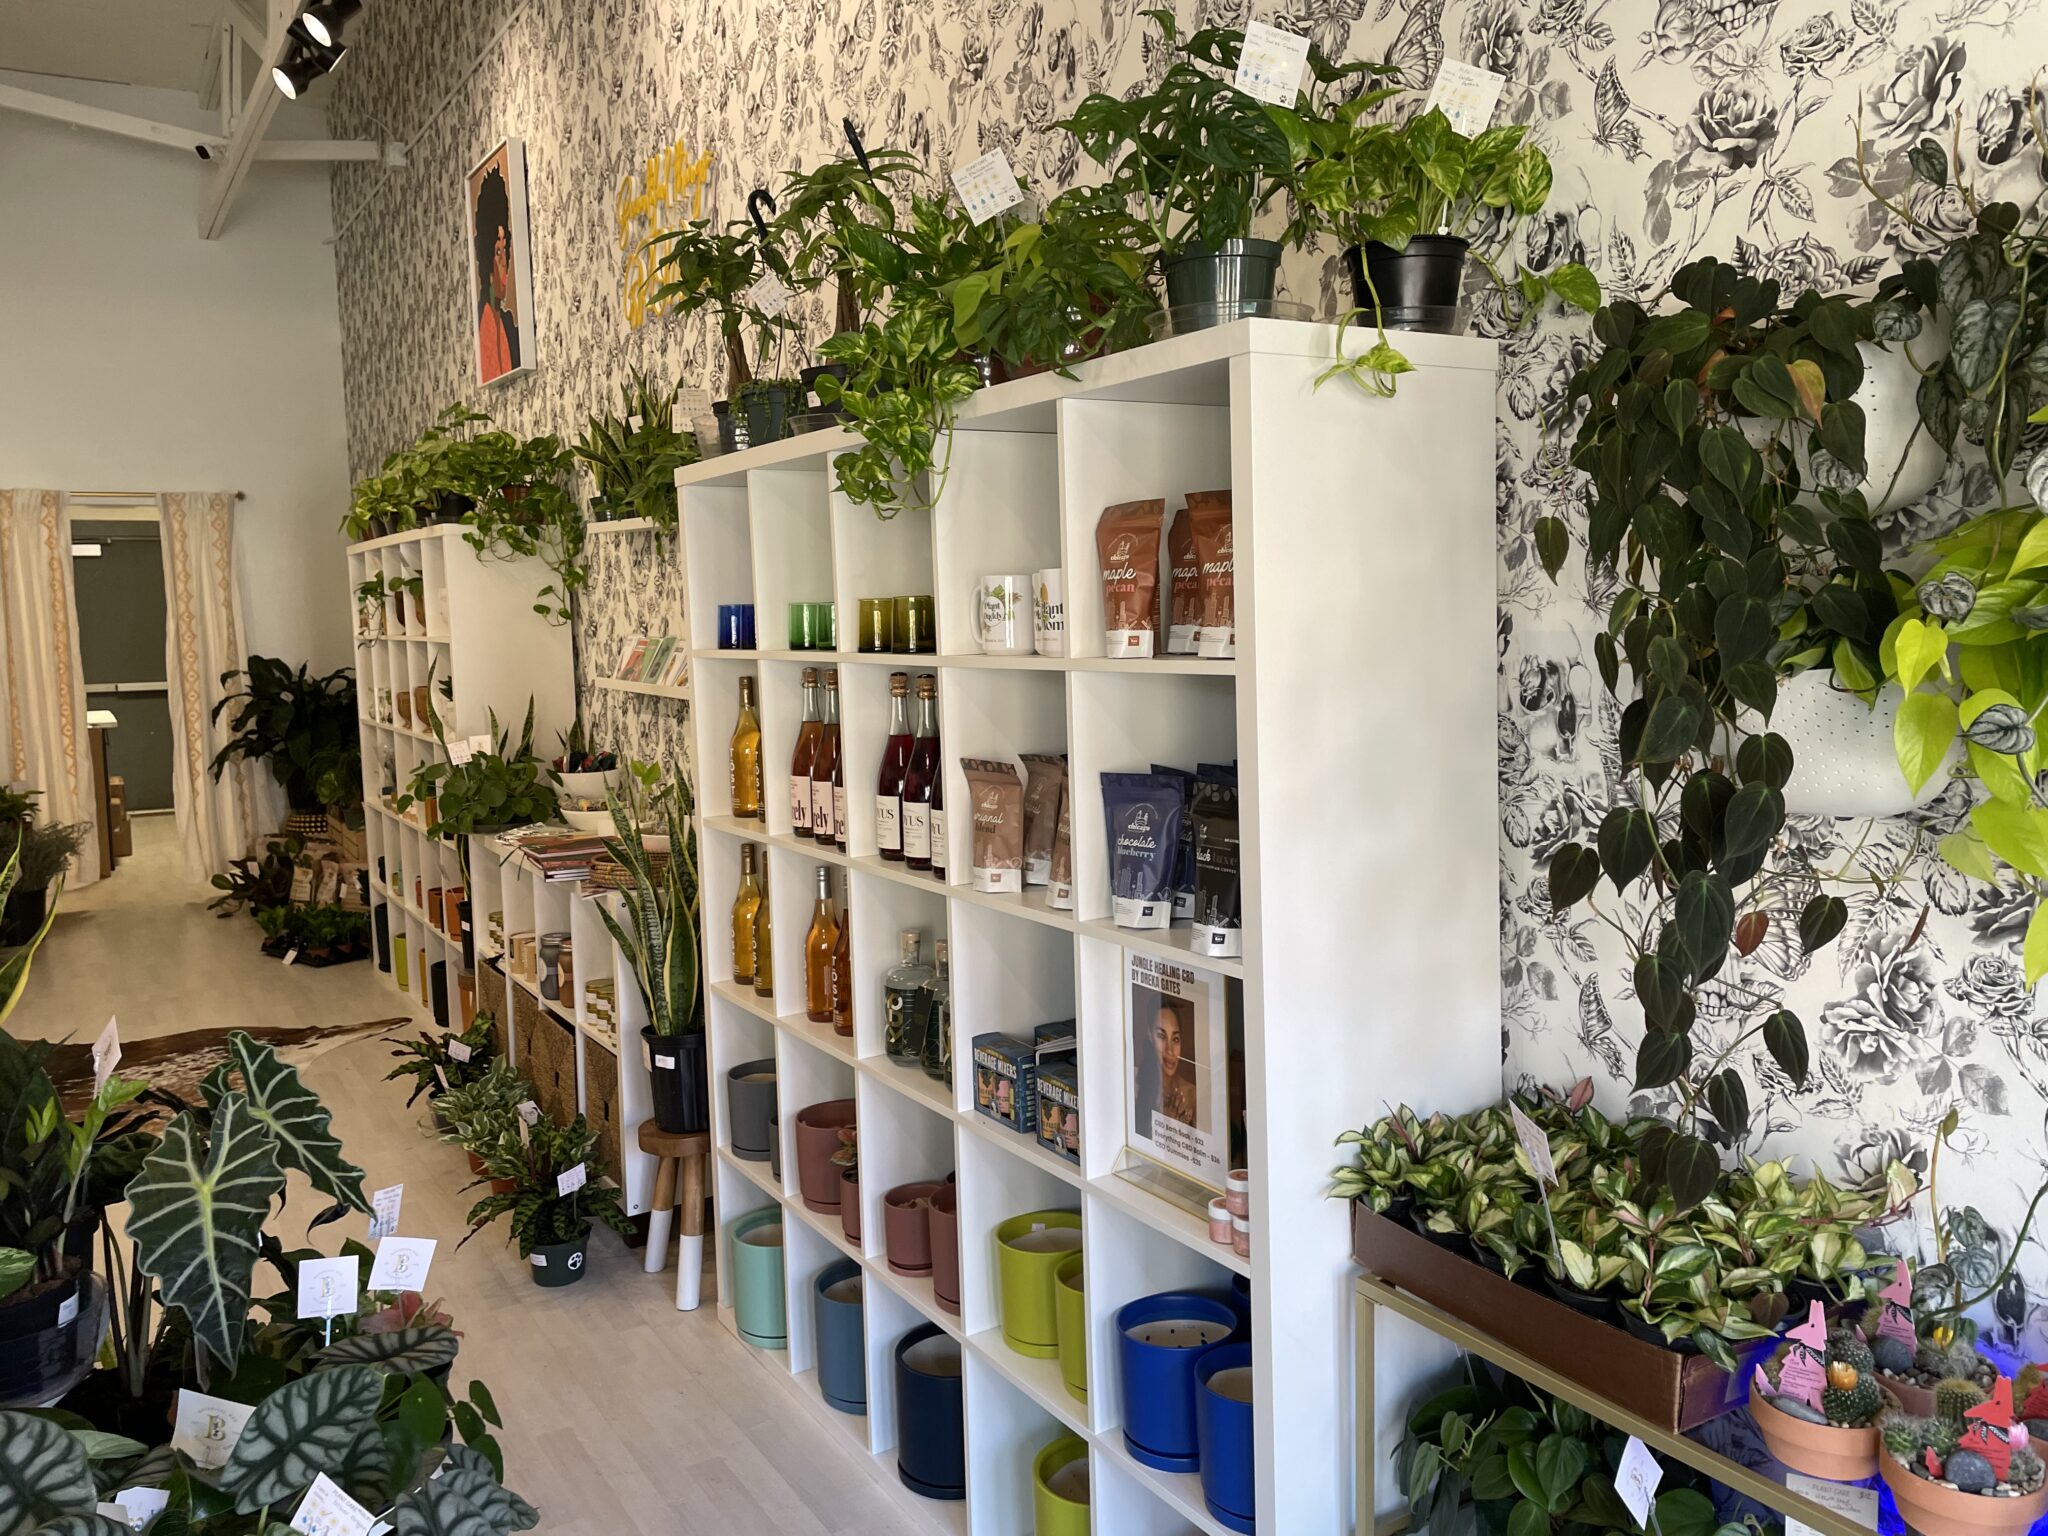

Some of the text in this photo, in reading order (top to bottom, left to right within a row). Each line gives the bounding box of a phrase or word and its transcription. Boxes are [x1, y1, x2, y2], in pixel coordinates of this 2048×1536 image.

[1102, 561, 1137, 586] maple
[1172, 566, 1199, 583] map
[1202, 559, 1234, 582] mapl
[1106, 583, 1136, 598] pecan
[1206, 576, 1233, 591] peca
[973, 812, 1004, 826] original
[1127, 822, 1151, 833] chicago
[975, 824, 996, 834] blend
[1117, 833, 1157, 849] chocolate
[1117, 846, 1155, 861] blueberry
[1132, 954, 1195, 984] JUNGLE HEALING CBD
[1132, 968, 1181, 995] BY DREKA GATES
[973, 1047, 997, 1071] BEVERAGE
[997, 1058, 1018, 1080] MIXERS
[1037, 1077, 1063, 1103] BEVERAGE
[1154, 1130, 1181, 1149] Everything
[1181, 1140, 1193, 1152] CBD
[1166, 1144, 1190, 1162] Gummies
